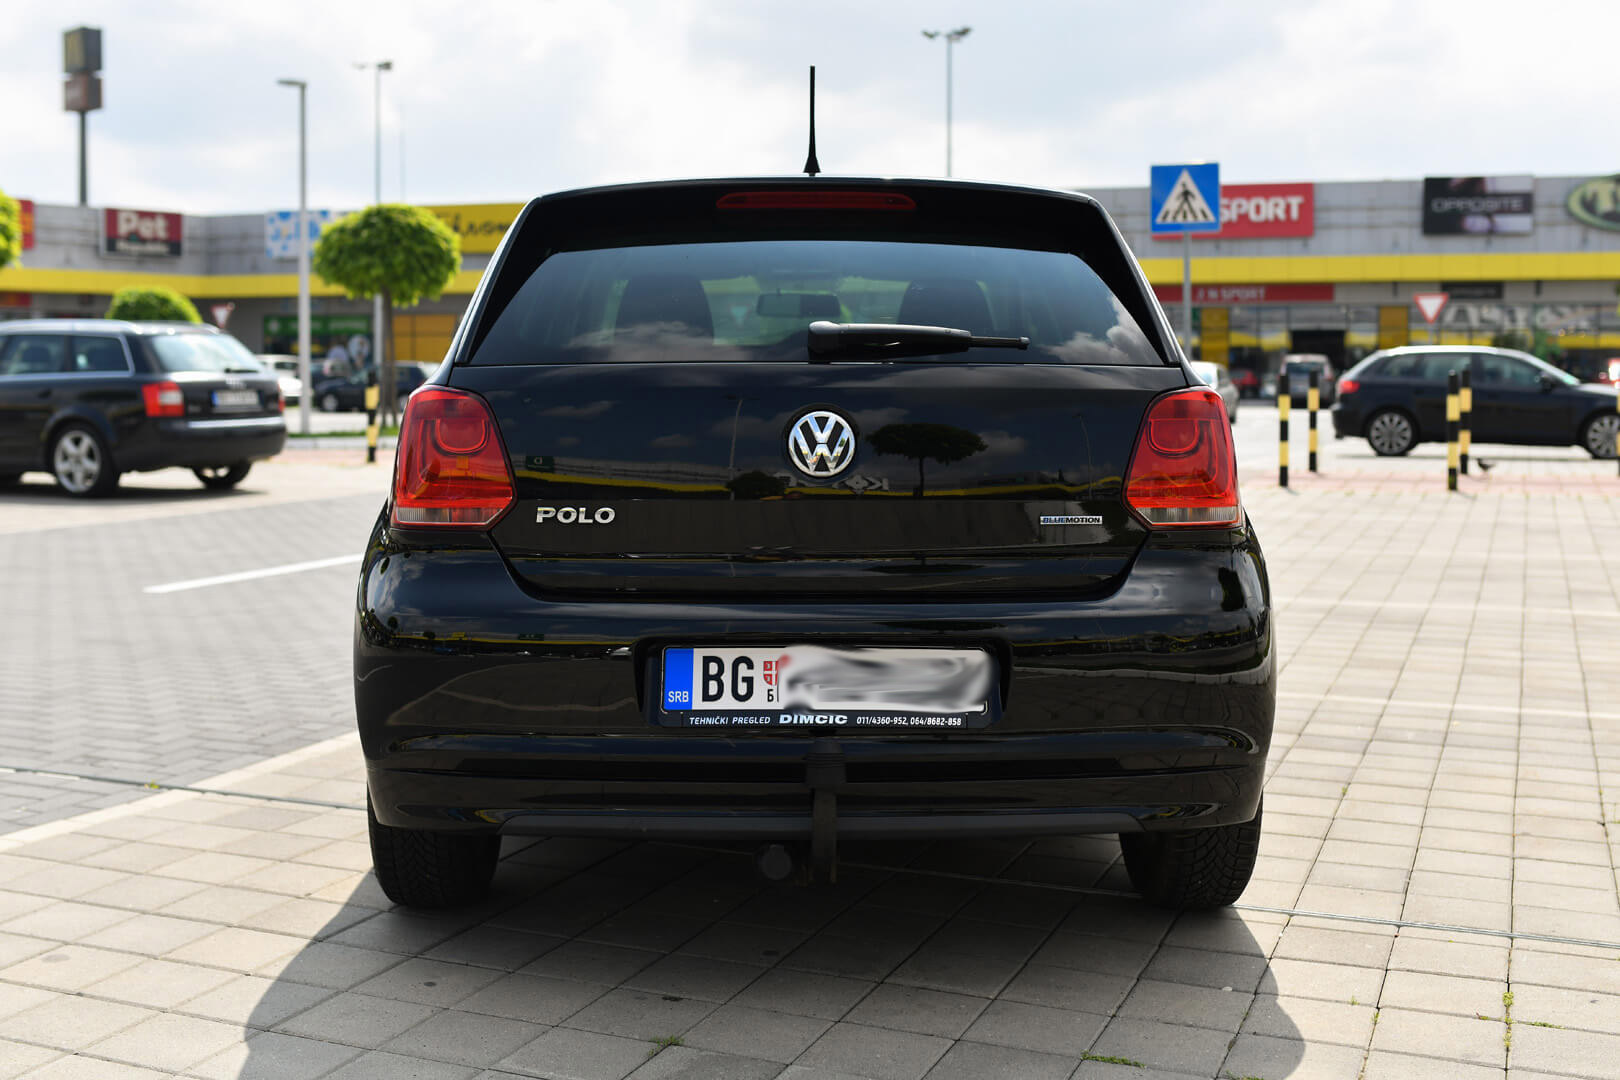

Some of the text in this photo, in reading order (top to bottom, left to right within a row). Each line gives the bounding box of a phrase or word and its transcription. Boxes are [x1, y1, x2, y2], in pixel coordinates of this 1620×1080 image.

[1220, 195, 1304, 223] SPORT
[1432, 197, 1524, 213] OPPOSITE
[117, 211, 169, 240] Pet
[535, 506, 616, 524] POLO
[1042, 516, 1101, 524] BLUEMOTION
[701, 655, 755, 702] BG
[667, 690, 689, 703] SRB
[689, 715, 729, 726] TEHNIČKI
[732, 716, 771, 725] PREGLED
